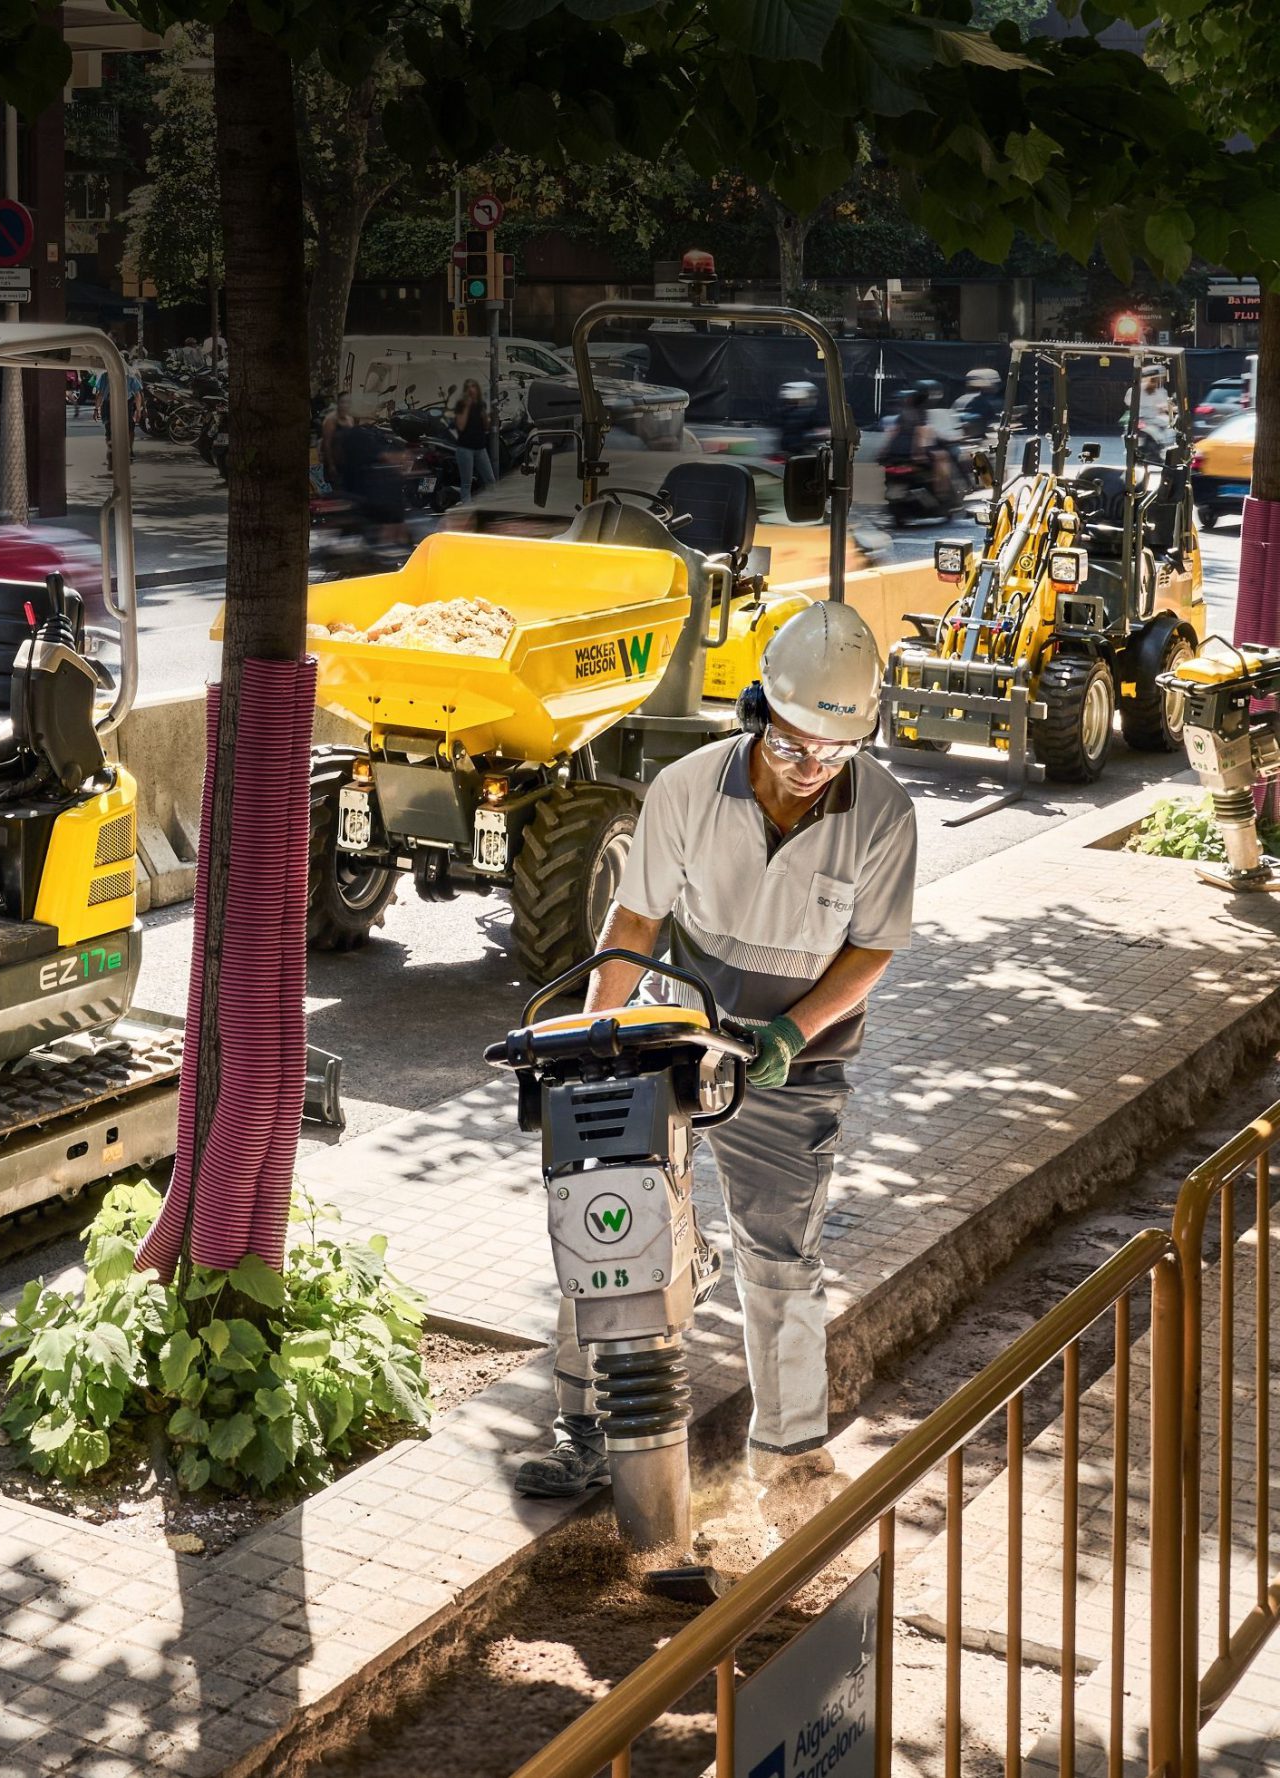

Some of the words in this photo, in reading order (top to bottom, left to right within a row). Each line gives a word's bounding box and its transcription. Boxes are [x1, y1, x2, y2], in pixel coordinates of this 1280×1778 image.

[1228, 296, 1261, 305] Balme
[1234, 311, 1260, 320] FLUI
[575, 641, 615, 663] WACKER
[575, 656, 617, 679] NEUSON
[817, 896, 854, 913] sorigu
[39, 948, 122, 990] EZ17e
[793, 1695, 845, 1767] Aigües
[847, 1674, 865, 1709] de
[795, 1711, 866, 1778] arcelona
